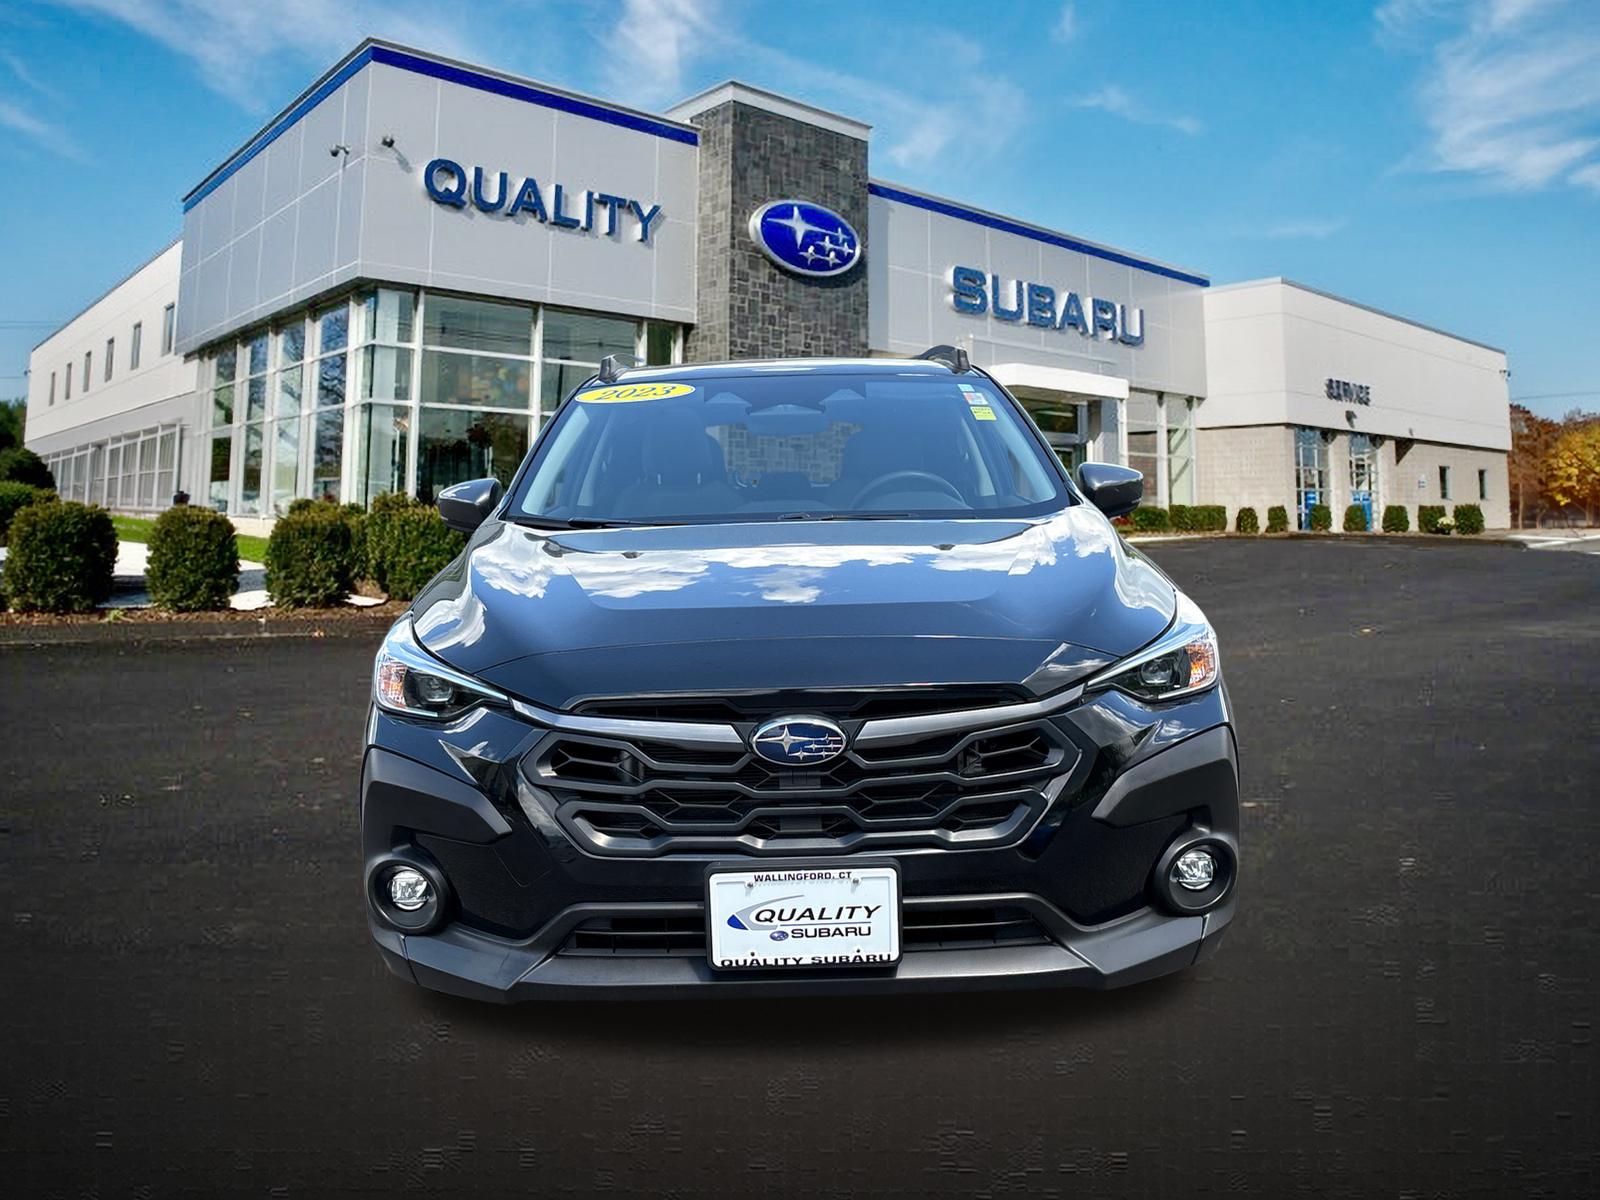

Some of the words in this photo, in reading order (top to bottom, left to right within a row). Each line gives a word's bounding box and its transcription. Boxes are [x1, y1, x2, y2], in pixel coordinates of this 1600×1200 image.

[424, 158, 662, 242] QUALITY
[952, 265, 1144, 346] SUBARU
[594, 386, 677, 401] 2023
[838, 871, 853, 879] CT
[755, 905, 882, 923] QUALITY
[791, 926, 871, 939] SUBARU
[720, 957, 804, 967] QUALITY
[811, 954, 891, 964] SUBARU
